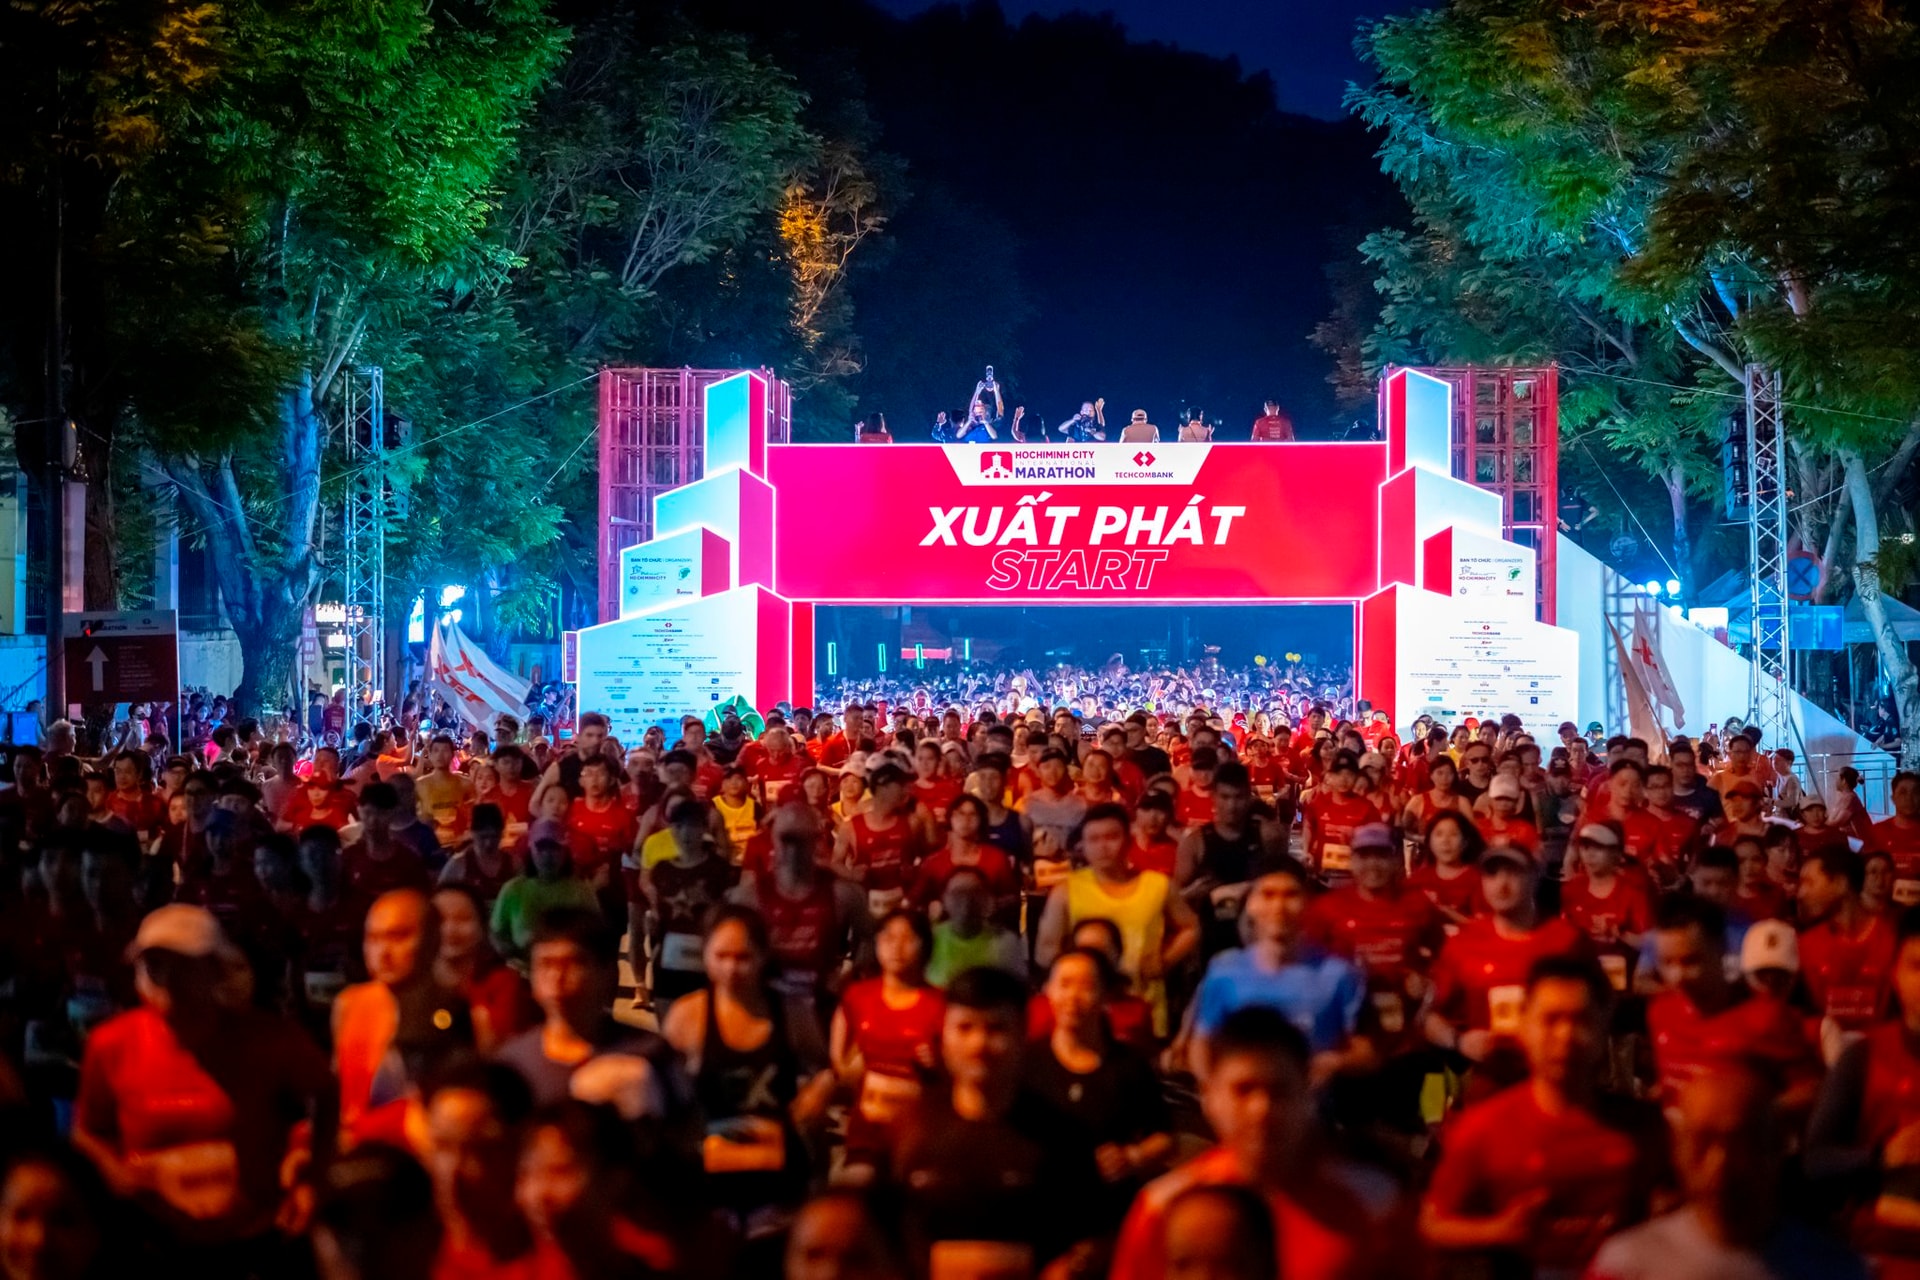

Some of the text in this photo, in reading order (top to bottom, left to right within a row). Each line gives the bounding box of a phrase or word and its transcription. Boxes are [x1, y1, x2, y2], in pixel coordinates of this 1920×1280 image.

[1015, 451, 1095, 459] HOCHIMINH CITY
[1015, 467, 1096, 479] MARATHON
[918, 490, 1247, 546] XUẤT PHÁT
[985, 549, 1169, 591] START
